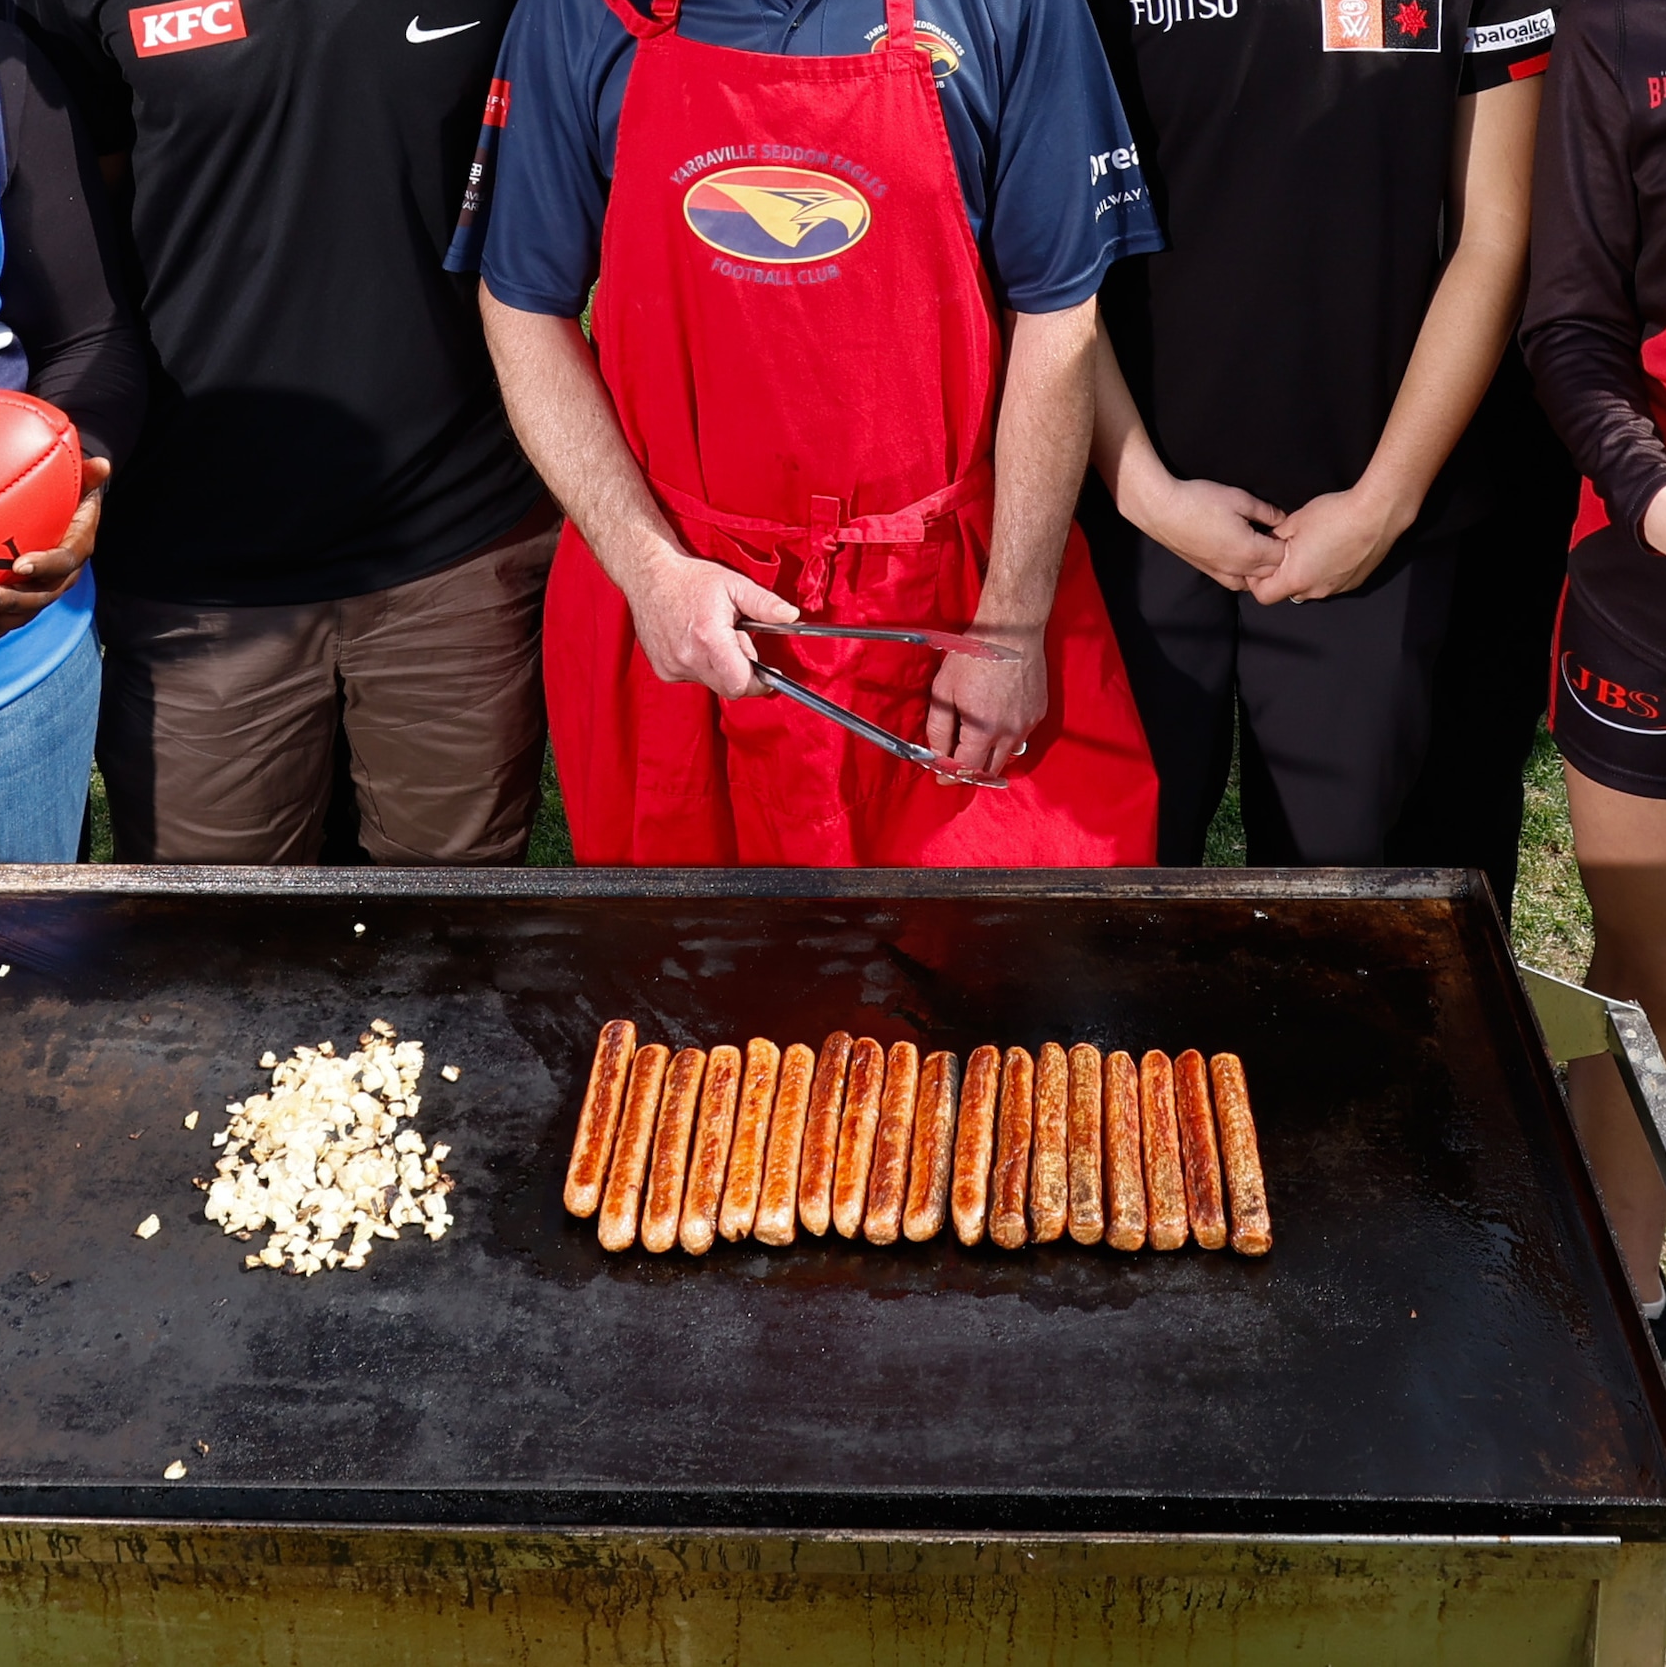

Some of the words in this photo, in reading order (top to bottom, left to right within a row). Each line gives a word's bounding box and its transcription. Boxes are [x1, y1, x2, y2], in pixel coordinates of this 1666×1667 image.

[142, 1, 233, 47] KFC
[864, 23, 888, 41] YARRA
[940, 31, 966, 57] EAGLES
[1475, 15, 1550, 47] paloalto
[670, 145, 757, 185] YARRAVILLE
[761, 144, 828, 165] SEDDON
[832, 155, 888, 198] EAGLES
[1094, 187, 1141, 224] AILWAY
[711, 258, 793, 285] FOOTBALL
[797, 265, 840, 285] CLUB
[1572, 664, 1660, 719] JBS
